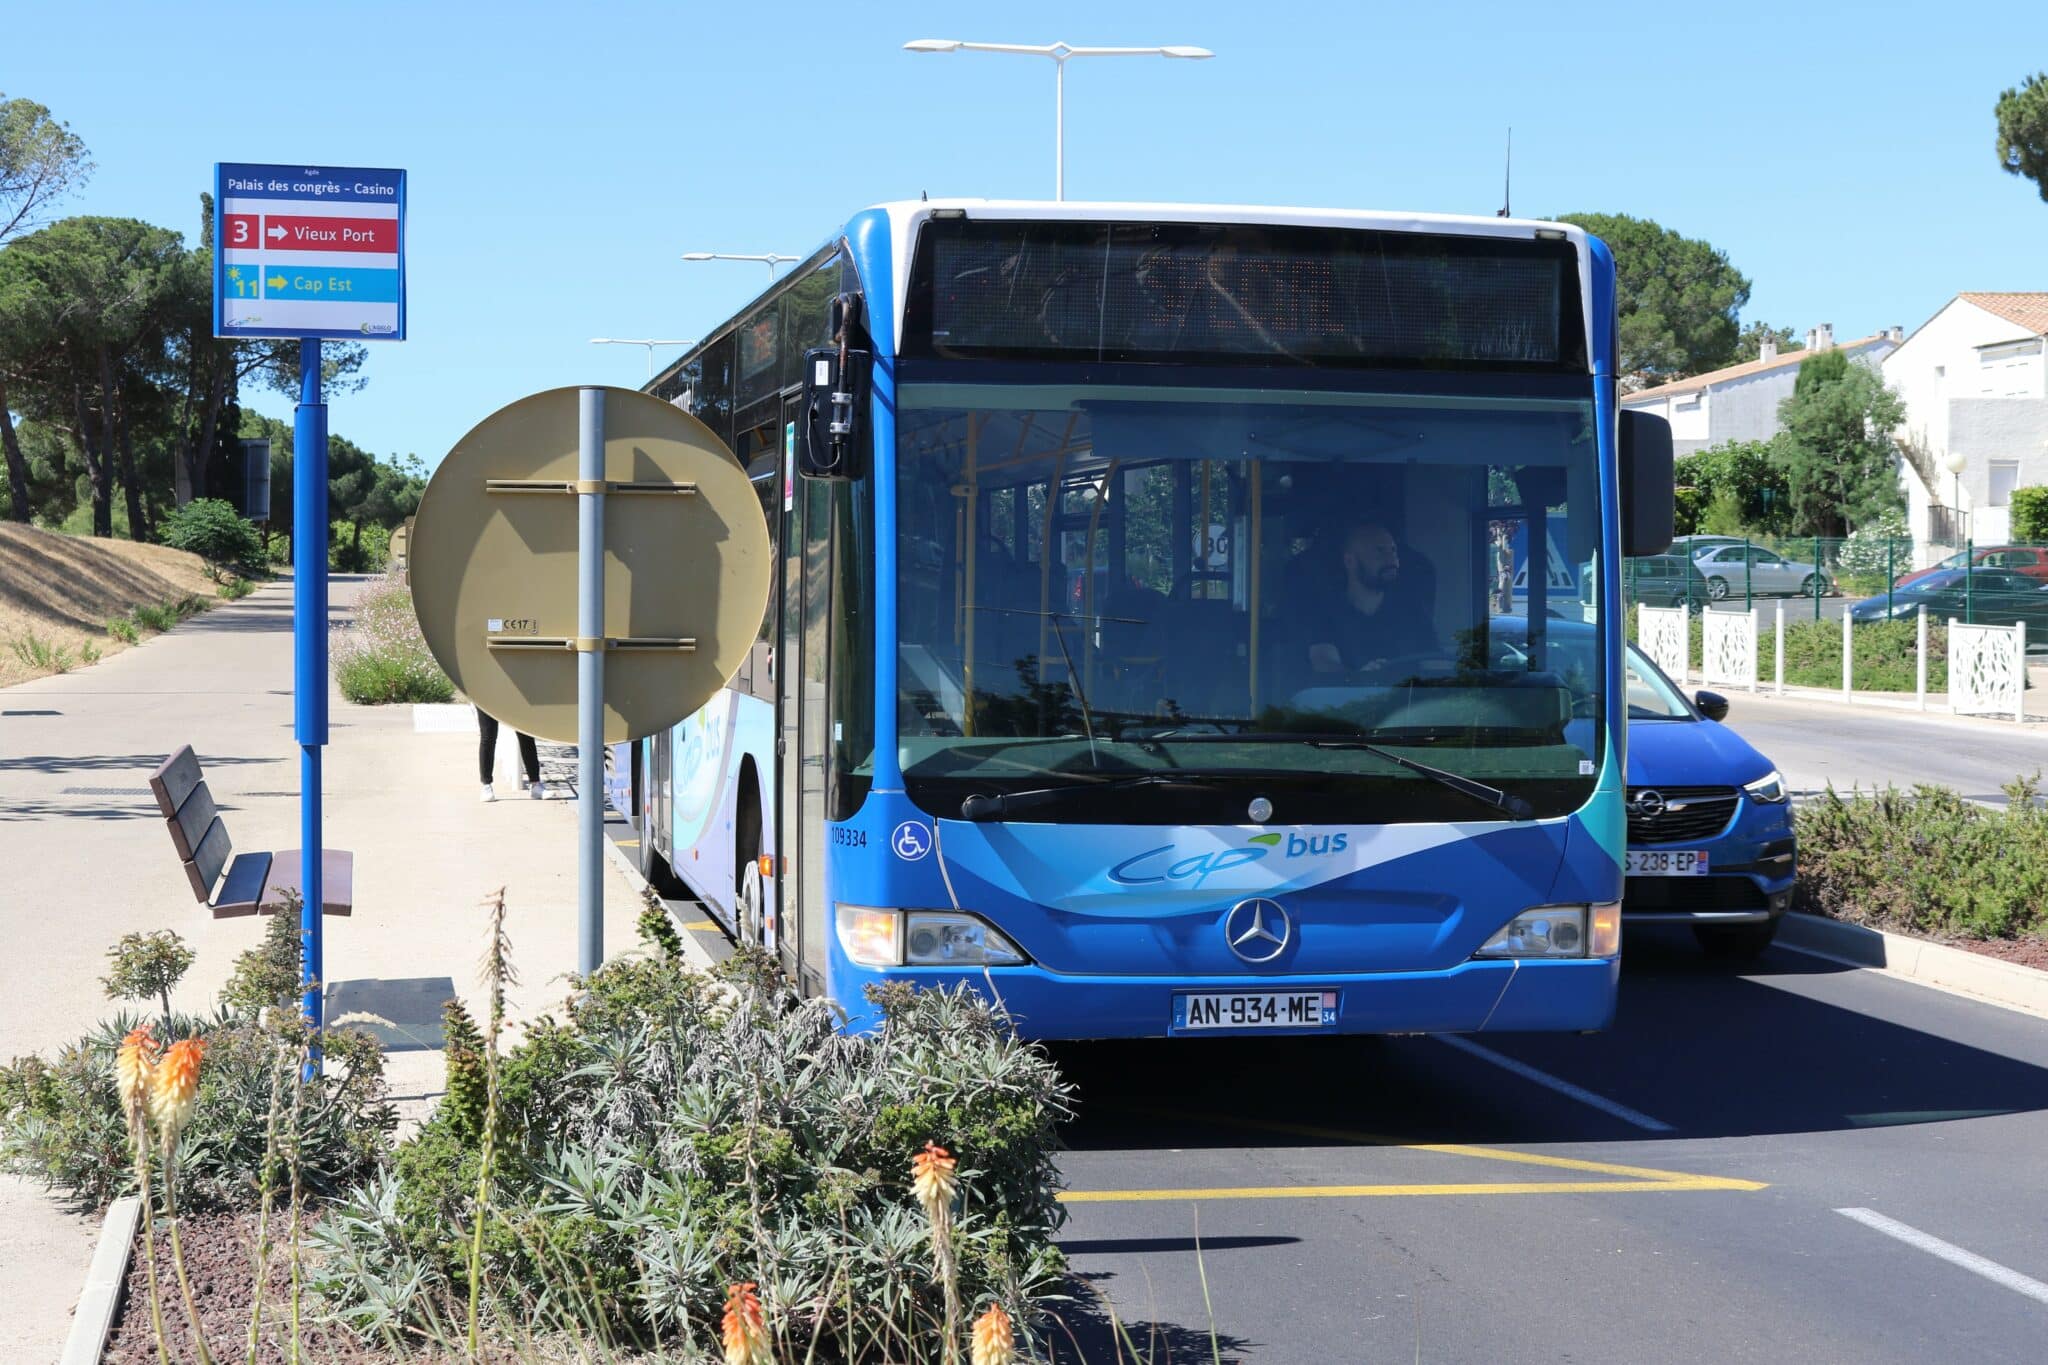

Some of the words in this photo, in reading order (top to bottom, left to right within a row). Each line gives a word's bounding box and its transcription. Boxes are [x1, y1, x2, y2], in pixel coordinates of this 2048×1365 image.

[304, 168, 320, 177] Agde
[228, 179, 264, 191] Palais
[268, 180, 289, 192] des
[293, 181, 340, 195] congrès
[354, 183, 394, 195] Casino
[233, 220, 248, 242] 3
[295, 226, 336, 241] Vieux
[343, 228, 375, 242] Port
[236, 280, 258, 297] 11
[294, 277, 322, 293] Cap
[329, 278, 352, 292] Est
[832, 826, 867, 848] 109334
[1107, 844, 1268, 889] Cap
[1286, 832, 1347, 858] bus
[1189, 996, 1320, 1025] AN-934-ME
[1322, 1011, 1335, 1023] 34
